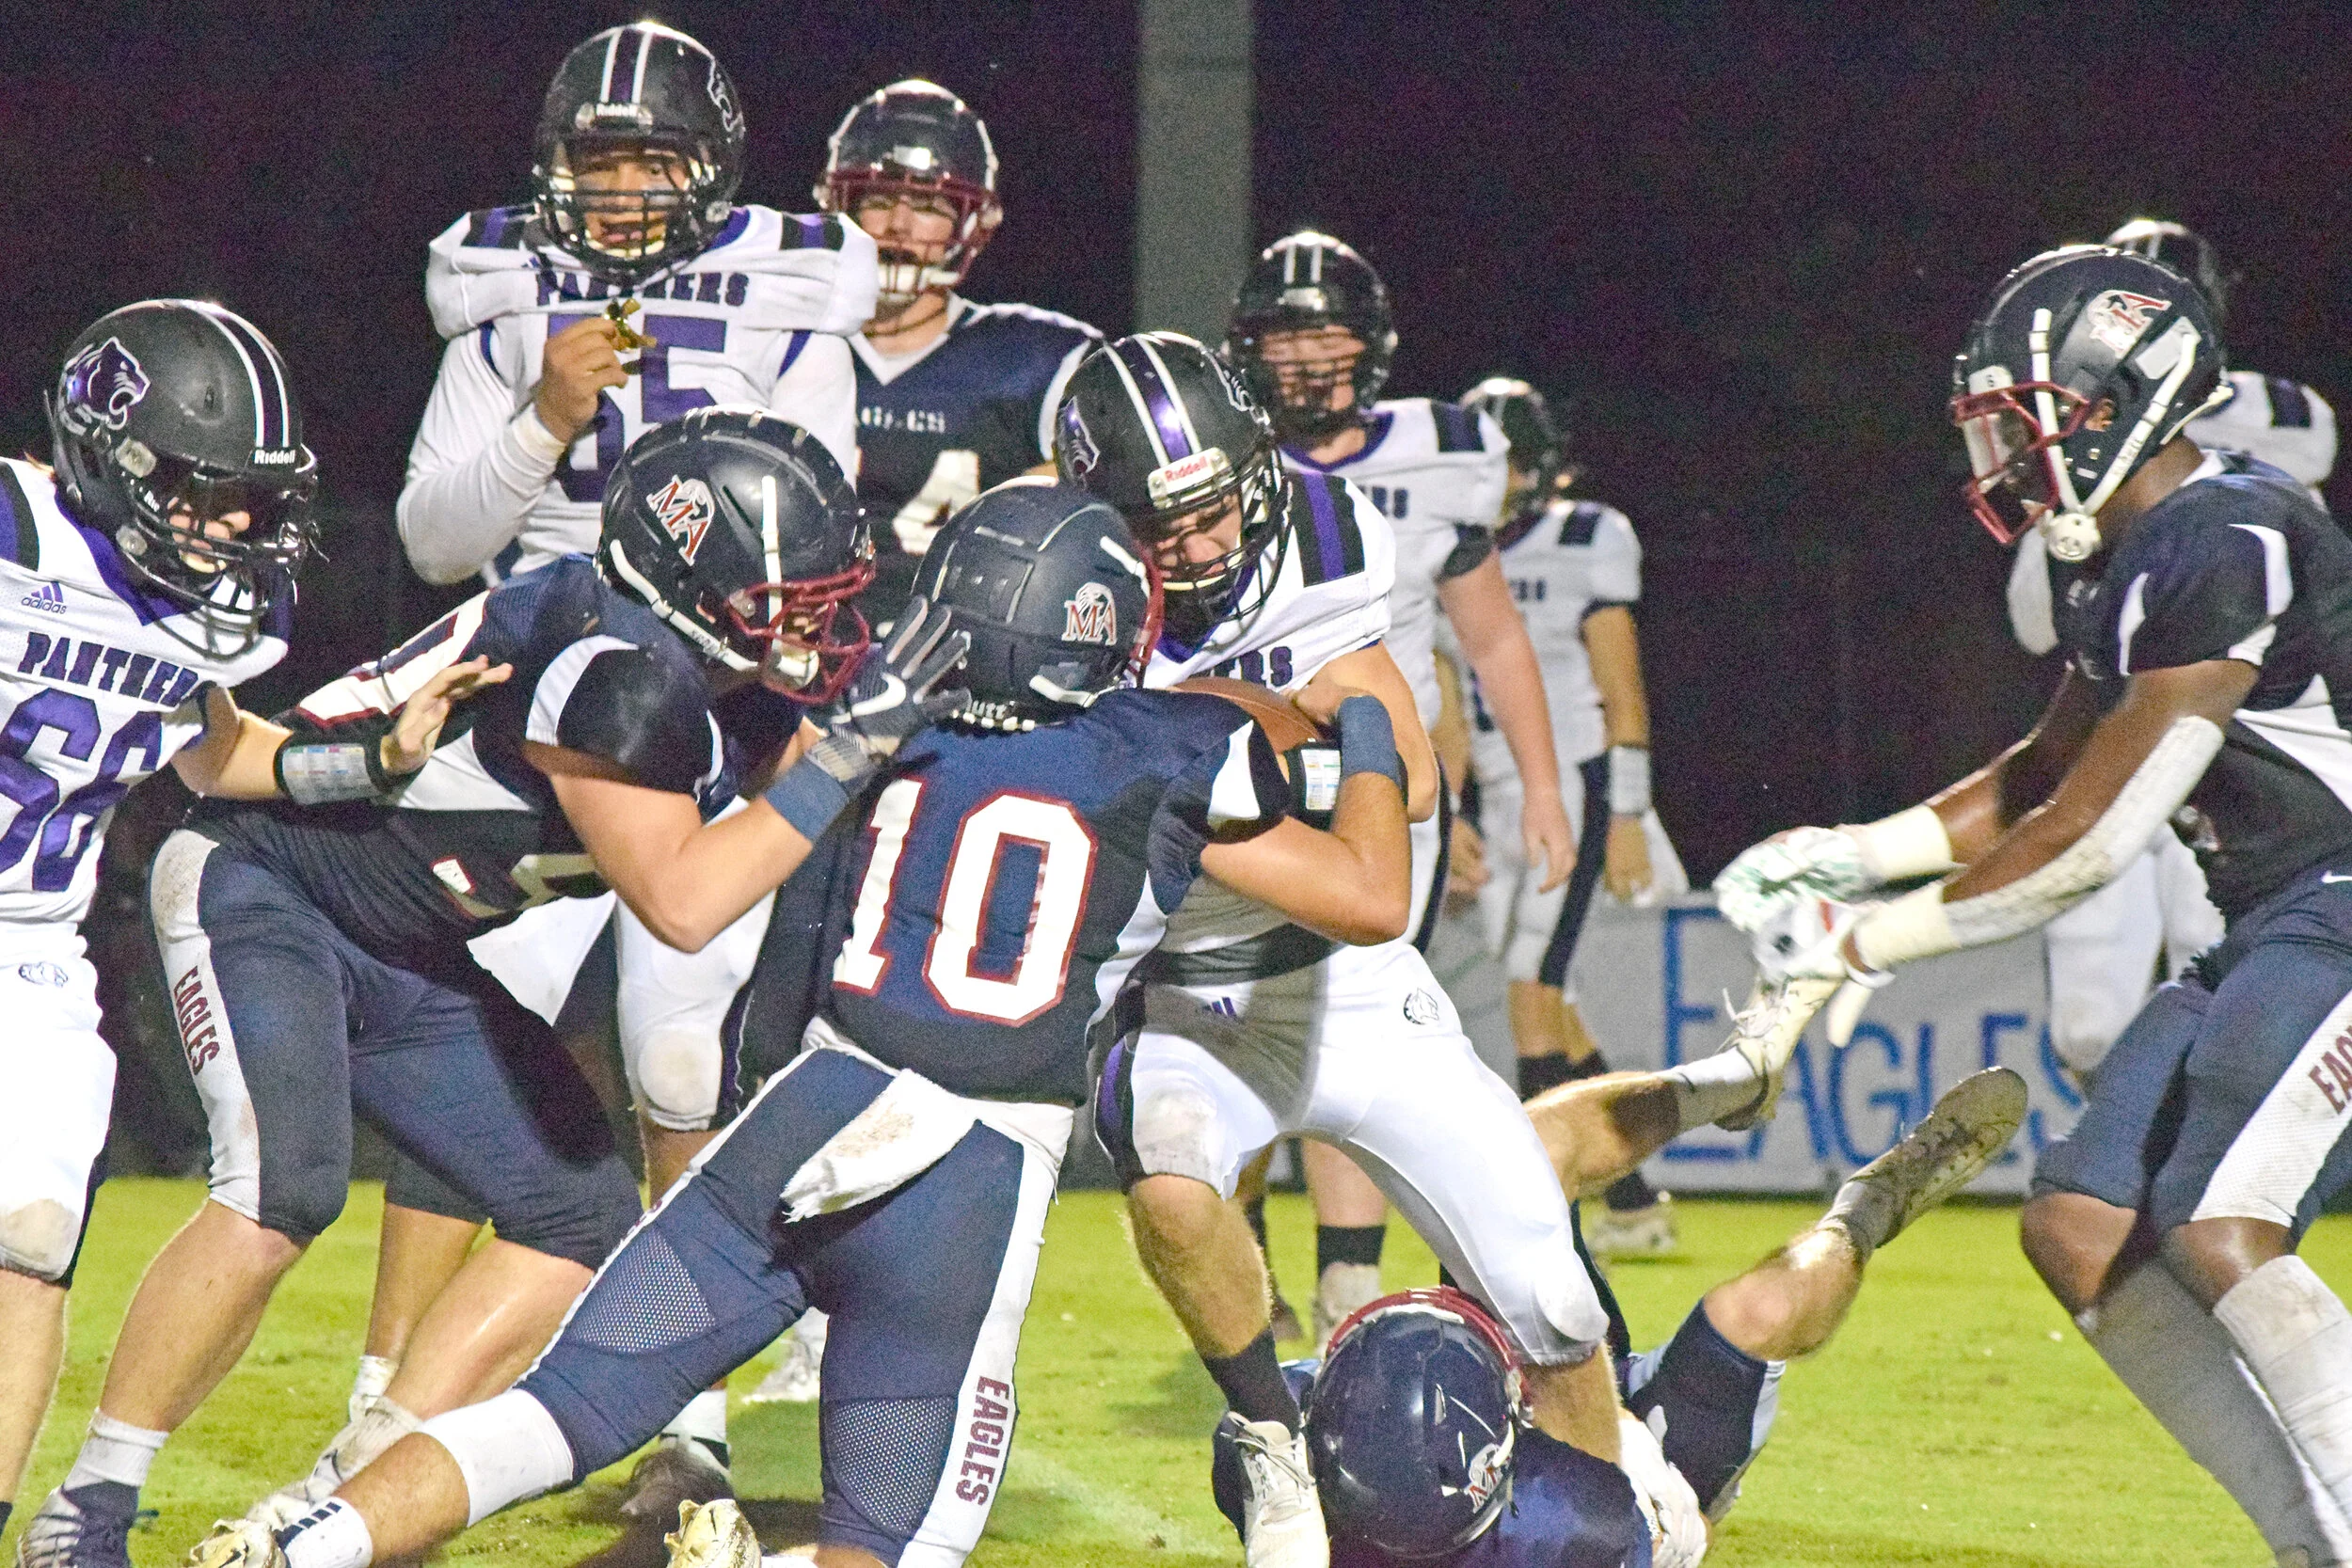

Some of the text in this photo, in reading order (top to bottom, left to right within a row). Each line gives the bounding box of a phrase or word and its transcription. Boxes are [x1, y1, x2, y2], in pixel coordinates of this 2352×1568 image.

[253, 449, 296, 465] Riddell
[21, 596, 67, 614] adidas
[1061, 582, 1118, 645] MA
[831, 774, 1099, 1028] 10
[173, 964, 220, 1075] EAGLES
[955, 1375, 1010, 1506] EAGLES
